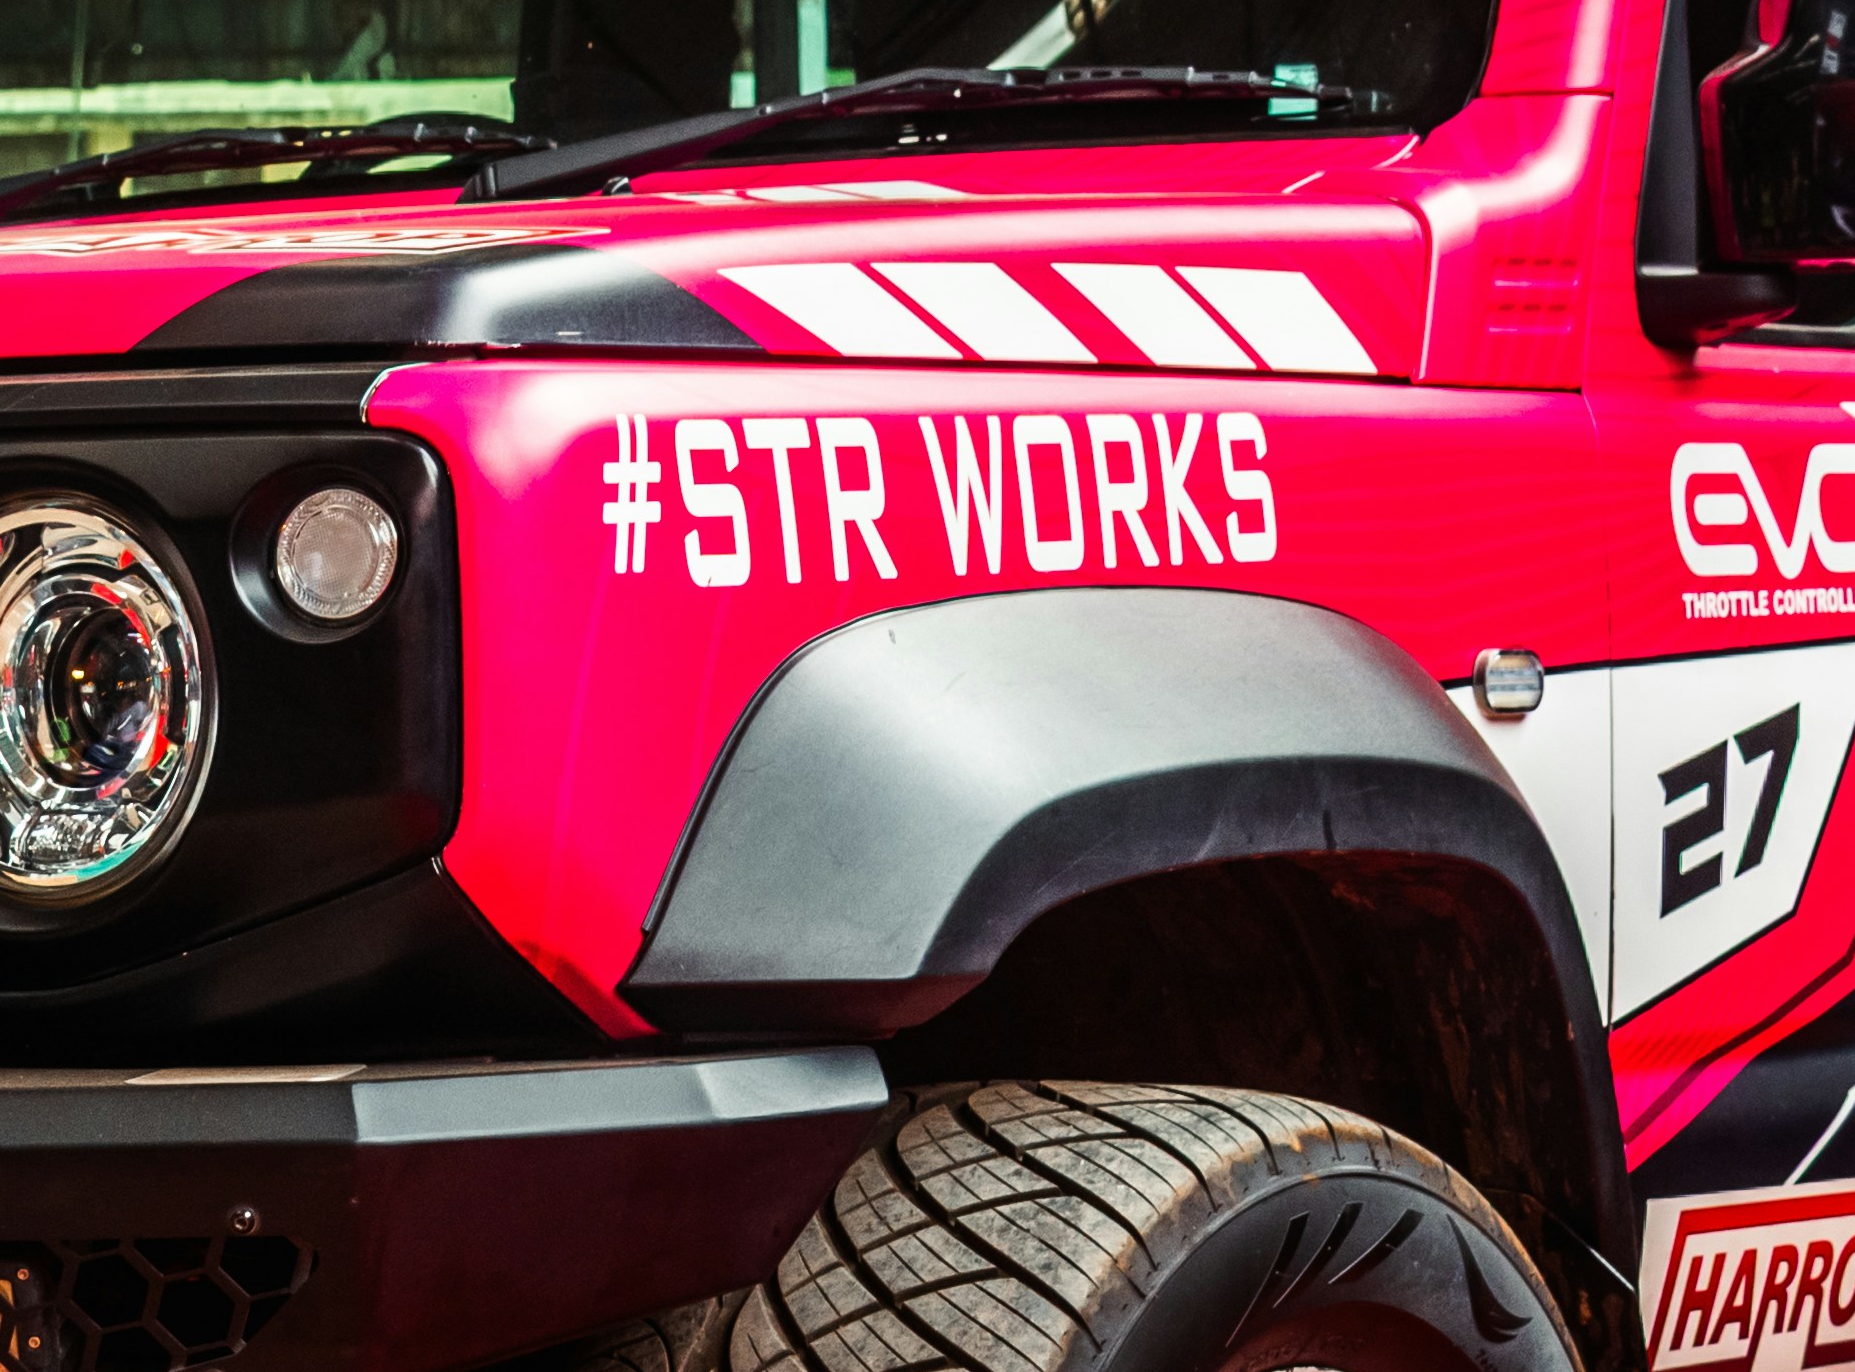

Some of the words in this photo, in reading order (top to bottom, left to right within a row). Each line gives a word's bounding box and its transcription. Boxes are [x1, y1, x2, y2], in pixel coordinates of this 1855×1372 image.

[602, 413, 898, 588] #STR
[918, 412, 1278, 577] WORKS
[1682, 590, 1769, 619] THROTTLE
[1657, 701, 1800, 919] 27
